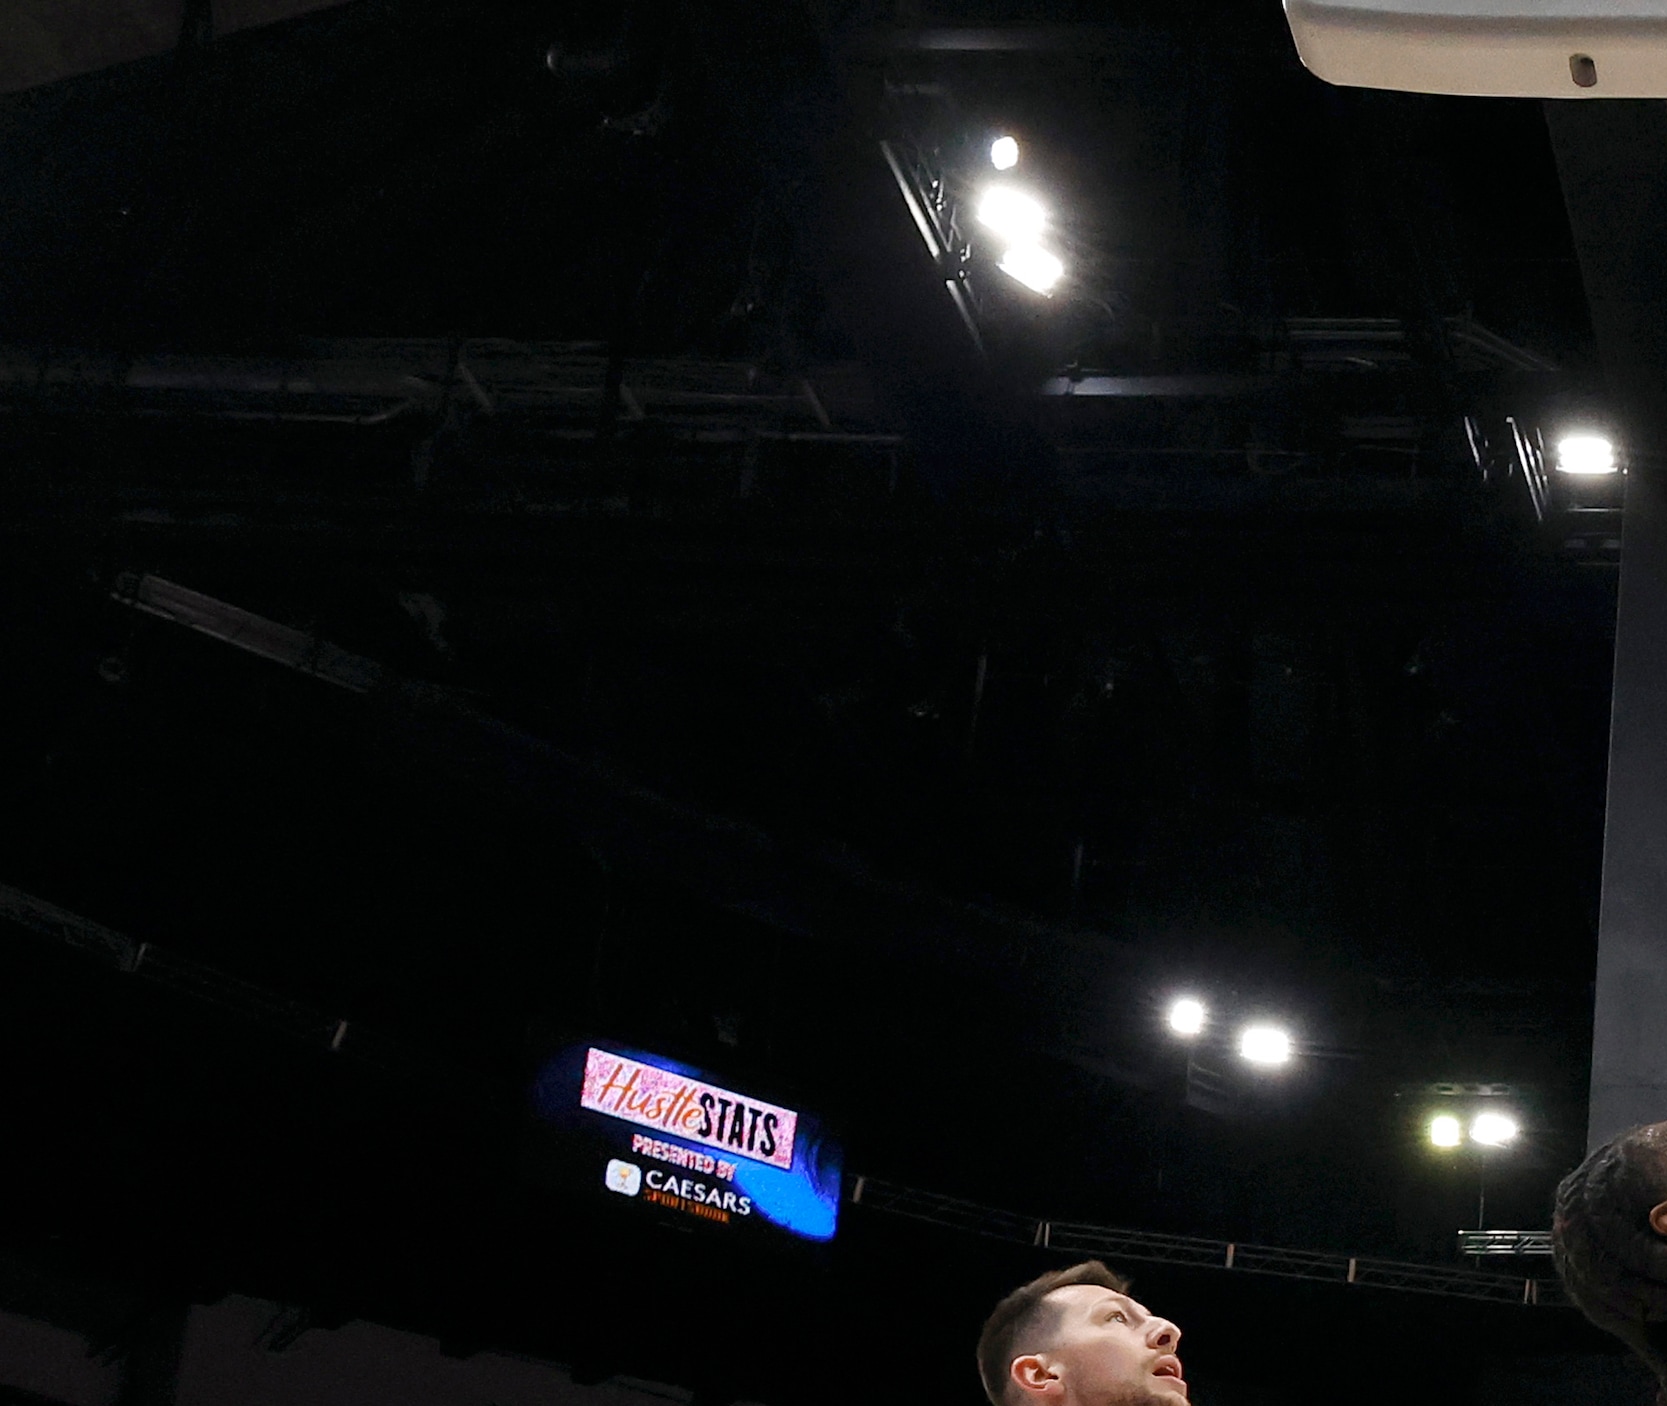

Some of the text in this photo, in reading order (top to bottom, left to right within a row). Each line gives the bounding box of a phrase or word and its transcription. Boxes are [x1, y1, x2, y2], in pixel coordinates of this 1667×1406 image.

[600, 1062, 778, 1158] Hustle STATS
[631, 1134, 738, 1182] PRESENTED BY
[646, 1169, 751, 1216] CAESARS
